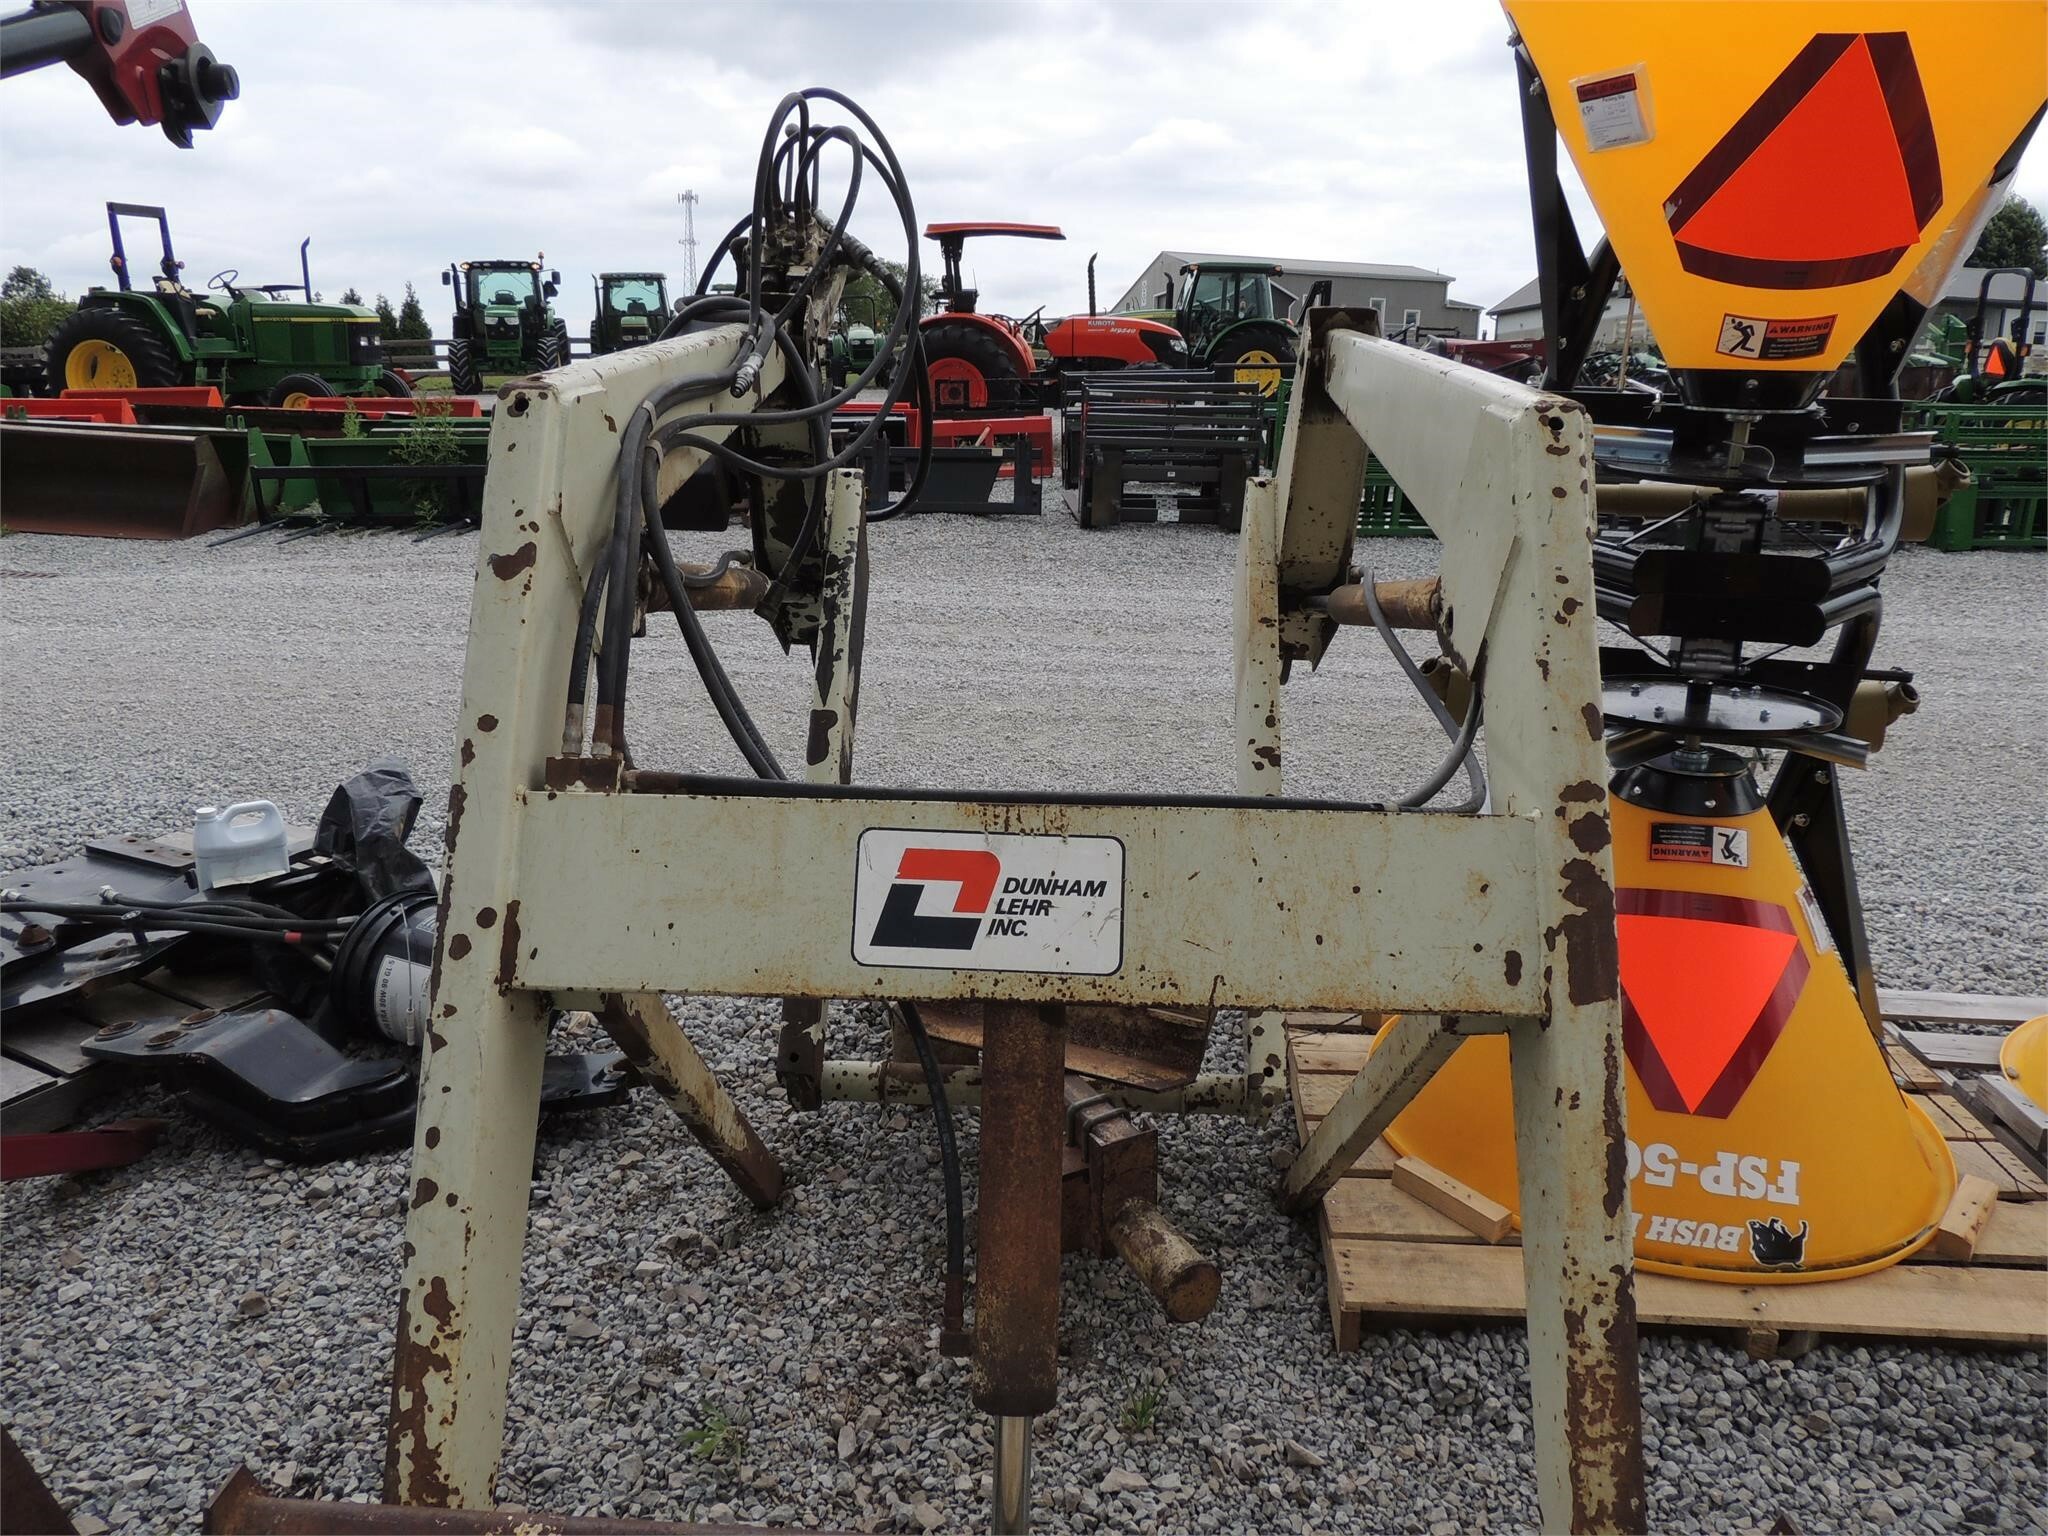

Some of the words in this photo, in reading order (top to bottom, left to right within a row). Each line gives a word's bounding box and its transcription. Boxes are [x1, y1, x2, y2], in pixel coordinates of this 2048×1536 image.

[1779, 322, 1830, 334] WARNING
[1652, 848, 1701, 857] WARNING
[1002, 877, 1108, 898] DUNHAM
[994, 898, 1052, 917] LEHR
[987, 918, 1029, 937] INC.
[1645, 1215, 1745, 1253] BUSH
